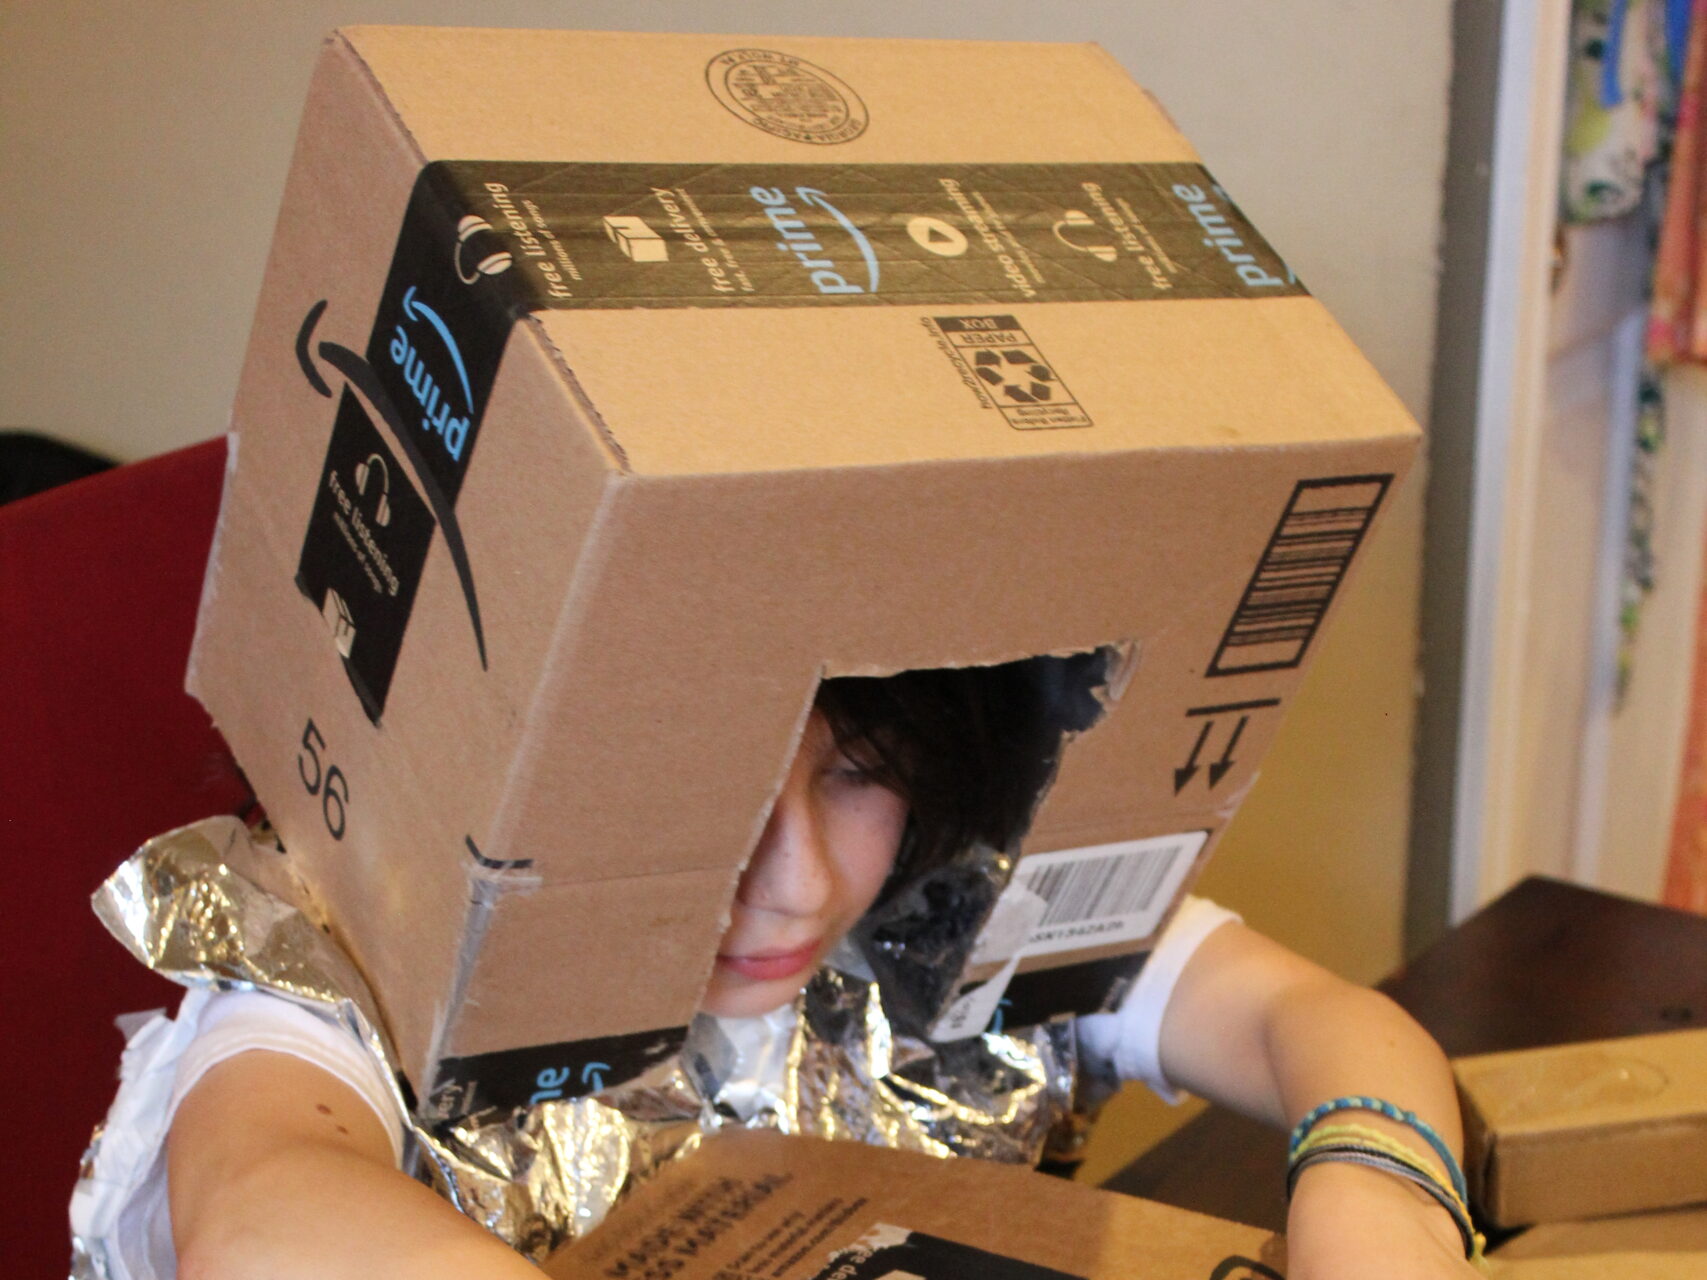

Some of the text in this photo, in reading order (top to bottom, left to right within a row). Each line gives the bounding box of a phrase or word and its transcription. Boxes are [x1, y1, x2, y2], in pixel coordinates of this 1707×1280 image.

[484, 182, 573, 298] free listening
[522, 200, 550, 229] songs
[551, 240, 582, 280] millions
[651, 187, 735, 292] free delivery
[750, 186, 864, 293] prime
[937, 178, 1036, 298] video streaming
[1081, 182, 1173, 290] free listening
[1172, 183, 1284, 287] prime
[959, 318, 998, 329] BOX
[960, 333, 1018, 344] PAPER
[390, 325, 471, 462] prime
[297, 717, 349, 842] 56
